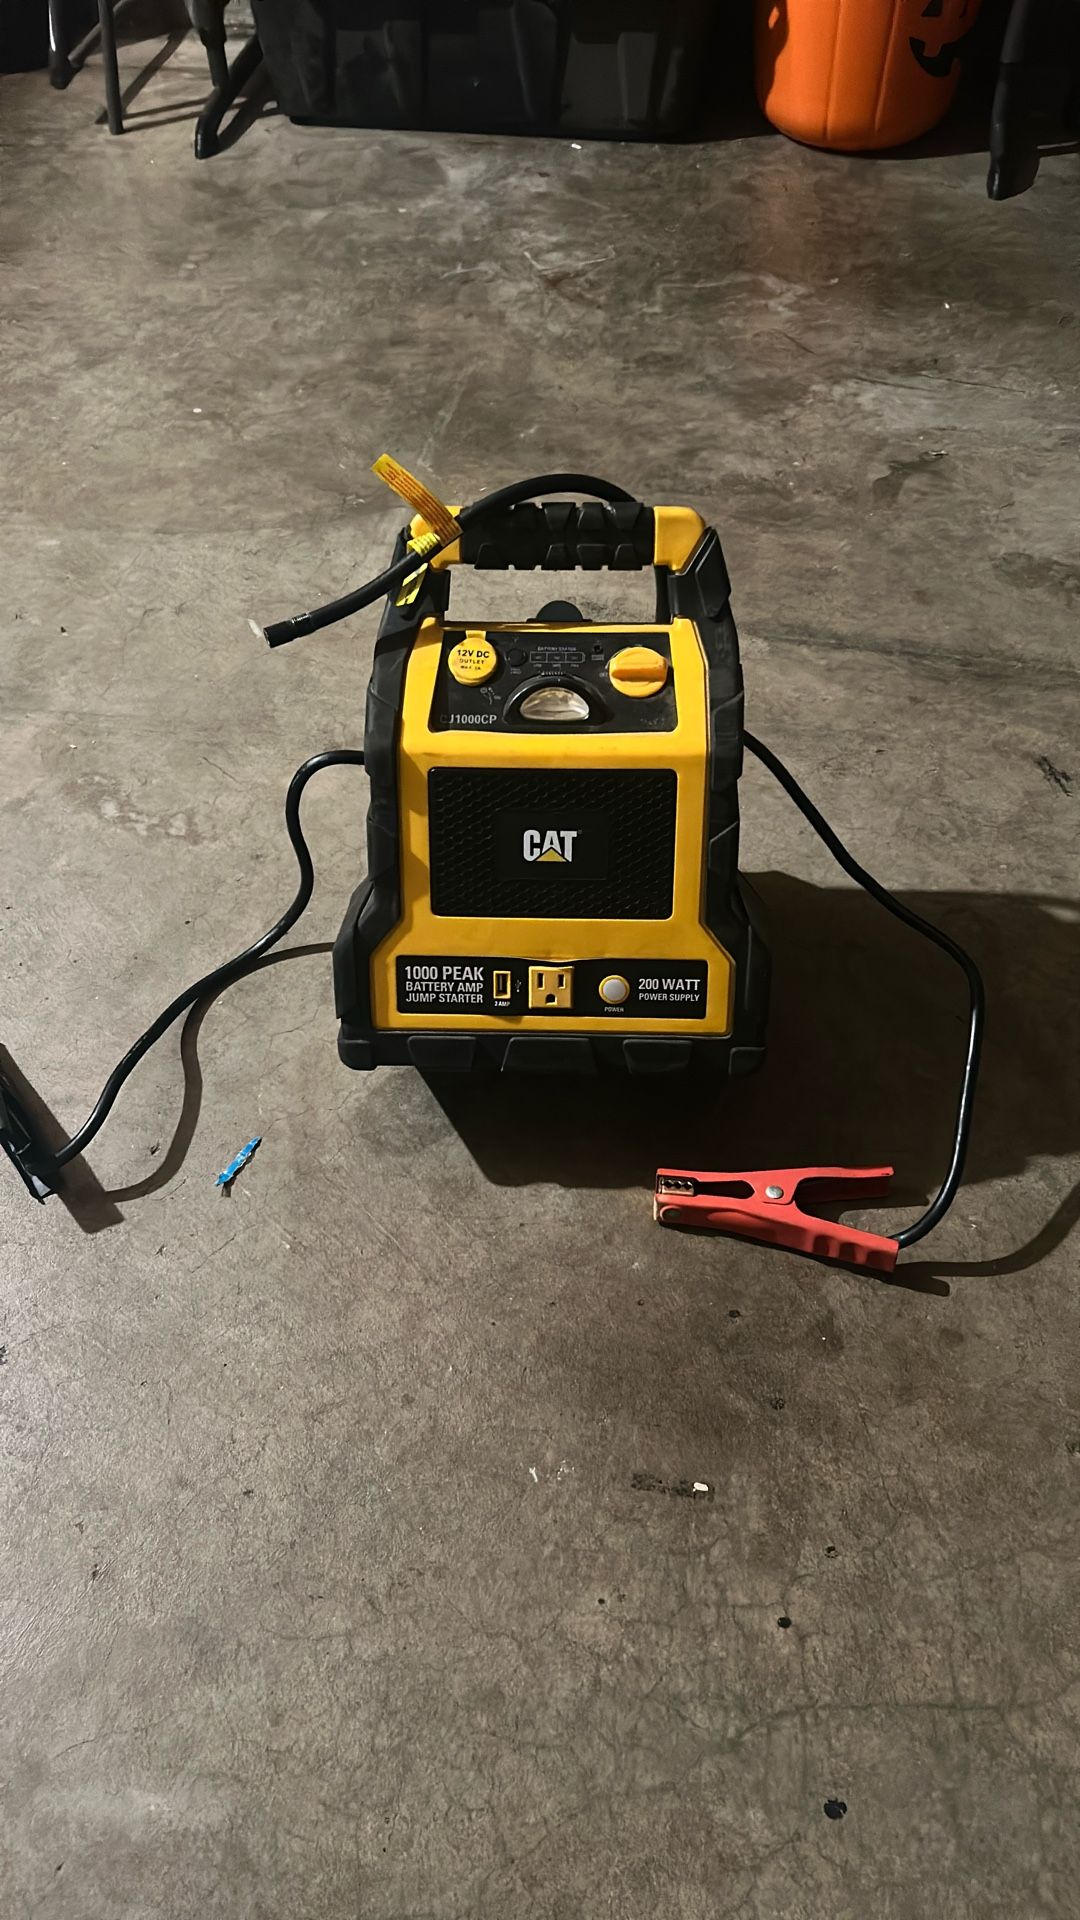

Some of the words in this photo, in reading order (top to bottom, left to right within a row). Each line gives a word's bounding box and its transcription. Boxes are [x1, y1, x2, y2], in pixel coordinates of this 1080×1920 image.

[457, 649, 474, 657] 12V
[476, 650, 490, 659] DC
[523, 829, 577, 862] CAT
[404, 966, 438, 980] 1000
[442, 966, 484, 981] PEAK
[405, 981, 454, 992] BATTERY
[457, 982, 484, 993] AMP
[638, 979, 659, 990] 200
[661, 979, 701, 991] WATT
[405, 993, 437, 1003] JUMP
[438, 993, 484, 1004] STARTER
[638, 992, 668, 1001] POWER
[669, 993, 700, 1002] SUPPLY
